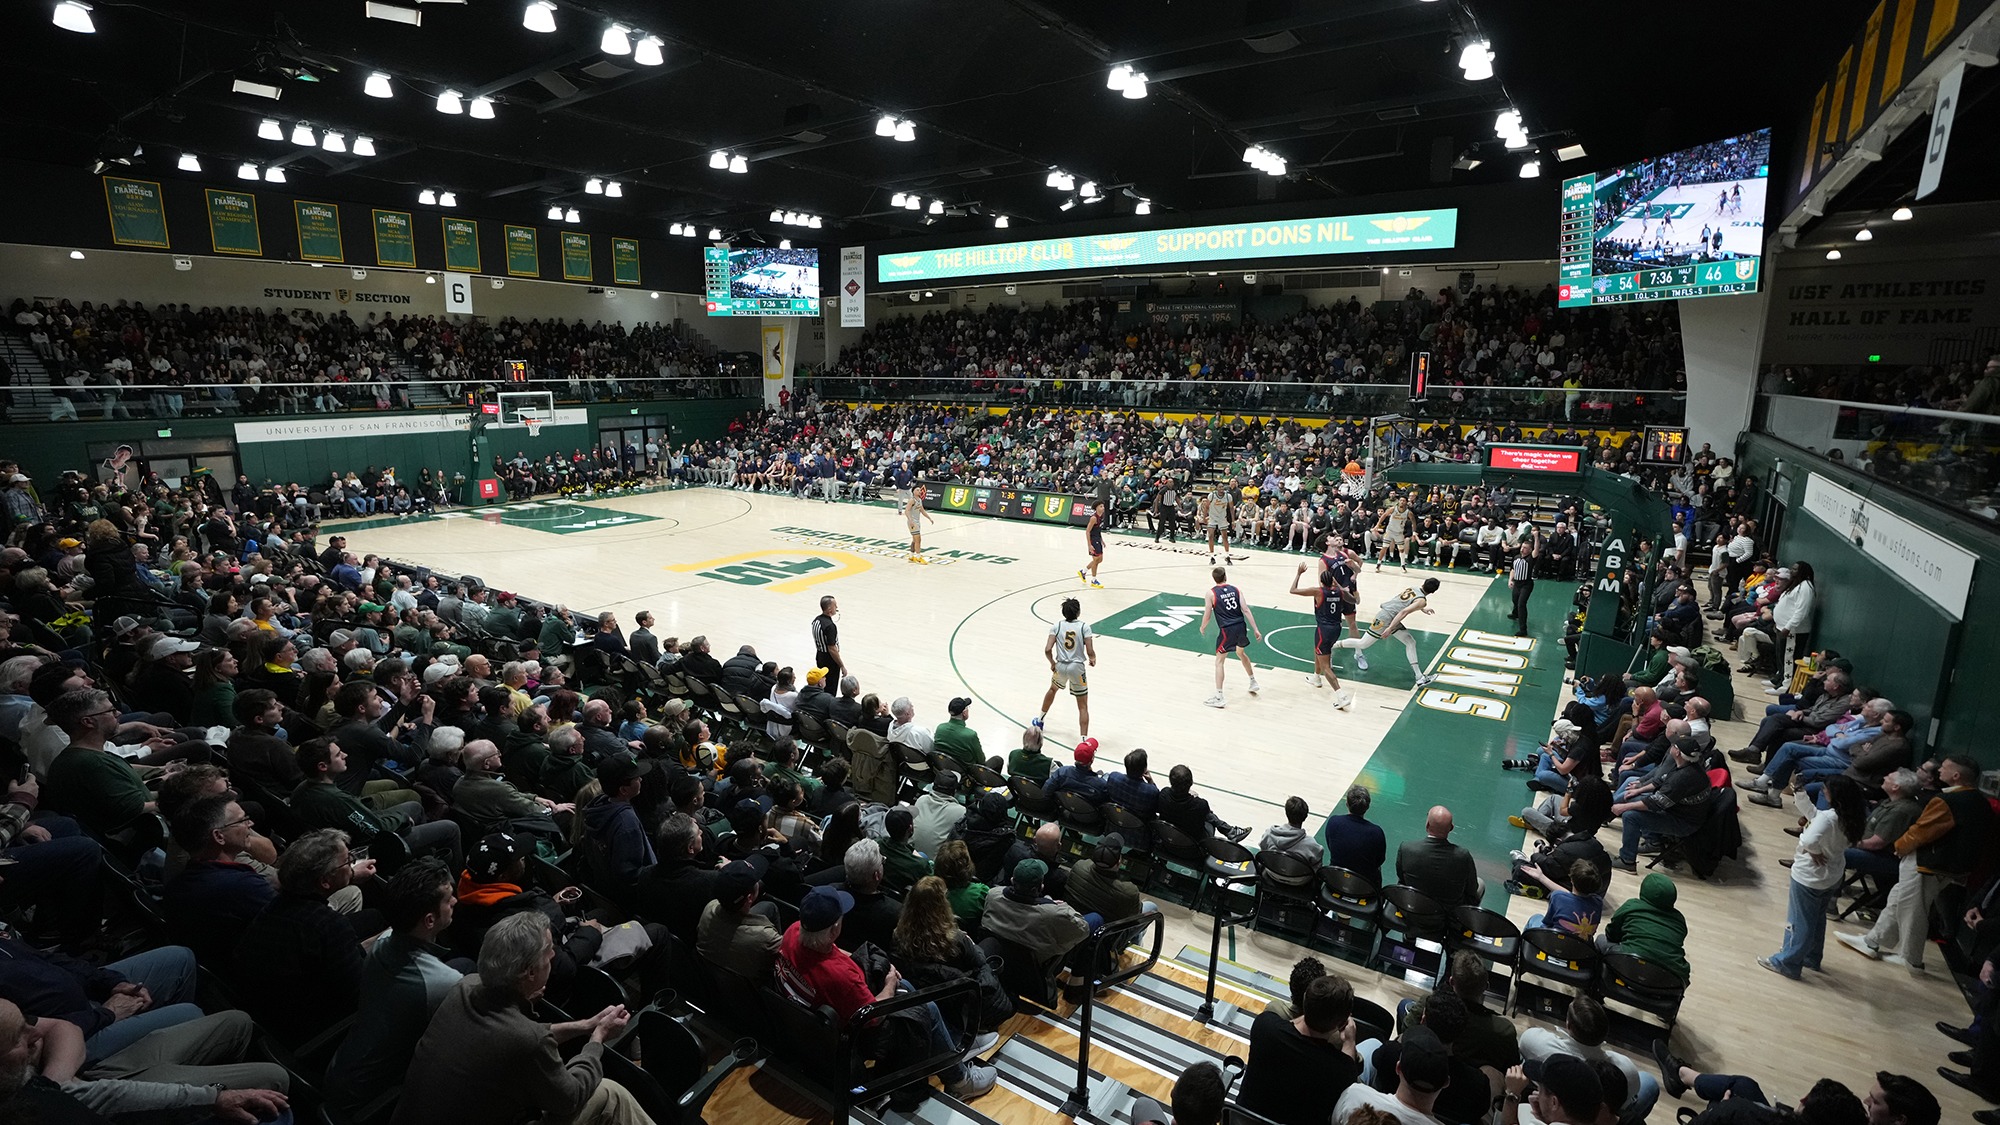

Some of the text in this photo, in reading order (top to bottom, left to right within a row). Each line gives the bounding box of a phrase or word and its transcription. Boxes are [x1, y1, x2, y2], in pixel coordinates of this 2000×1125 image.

[114, 186, 153, 198] FRANCISCO
[214, 198, 248, 208] FRANCISCO
[302, 208, 332, 218] FRANCISCO
[379, 216, 406, 226] FRANCISCO
[1156, 222, 1354, 252] SUPPORT DONS NIL
[935, 242, 1074, 268] THE HILLTOP CLUB
[1650, 271, 1672, 285] 7:36
[1682, 276, 1687, 284] 2
[1706, 266, 1722, 281] 46
[1620, 276, 1632, 290] 54
[1789, 280, 1986, 300] USF ATHLETICS
[264, 288, 331, 300] STUDENT
[355, 292, 410, 304] SECTION
[452, 283, 464, 304] 6
[1152, 312, 1231, 323] 1949 1955 1956
[1790, 308, 1973, 326] HALL OF FAME
[510, 362, 524, 370] 7:36
[266, 425, 338, 436] UNIVERSITY
[360, 422, 380, 432] SAN
[384, 420, 442, 430] FRANCISCO
[1658, 431, 1682, 444] 7:36
[1658, 444, 1676, 459] 11
[1001, 491, 1016, 500] 7:36
[770, 526, 1020, 564] SAN FRANCISCO
[808, 539, 957, 565] UNVERSITY
[1873, 528, 1943, 582] www.usfdons.com
[1340, 566, 1345, 576] 1
[1224, 597, 1238, 610] 33
[1330, 602, 1336, 614] 9
[1064, 631, 1076, 650] 5
[1416, 628, 1537, 722] DONS
